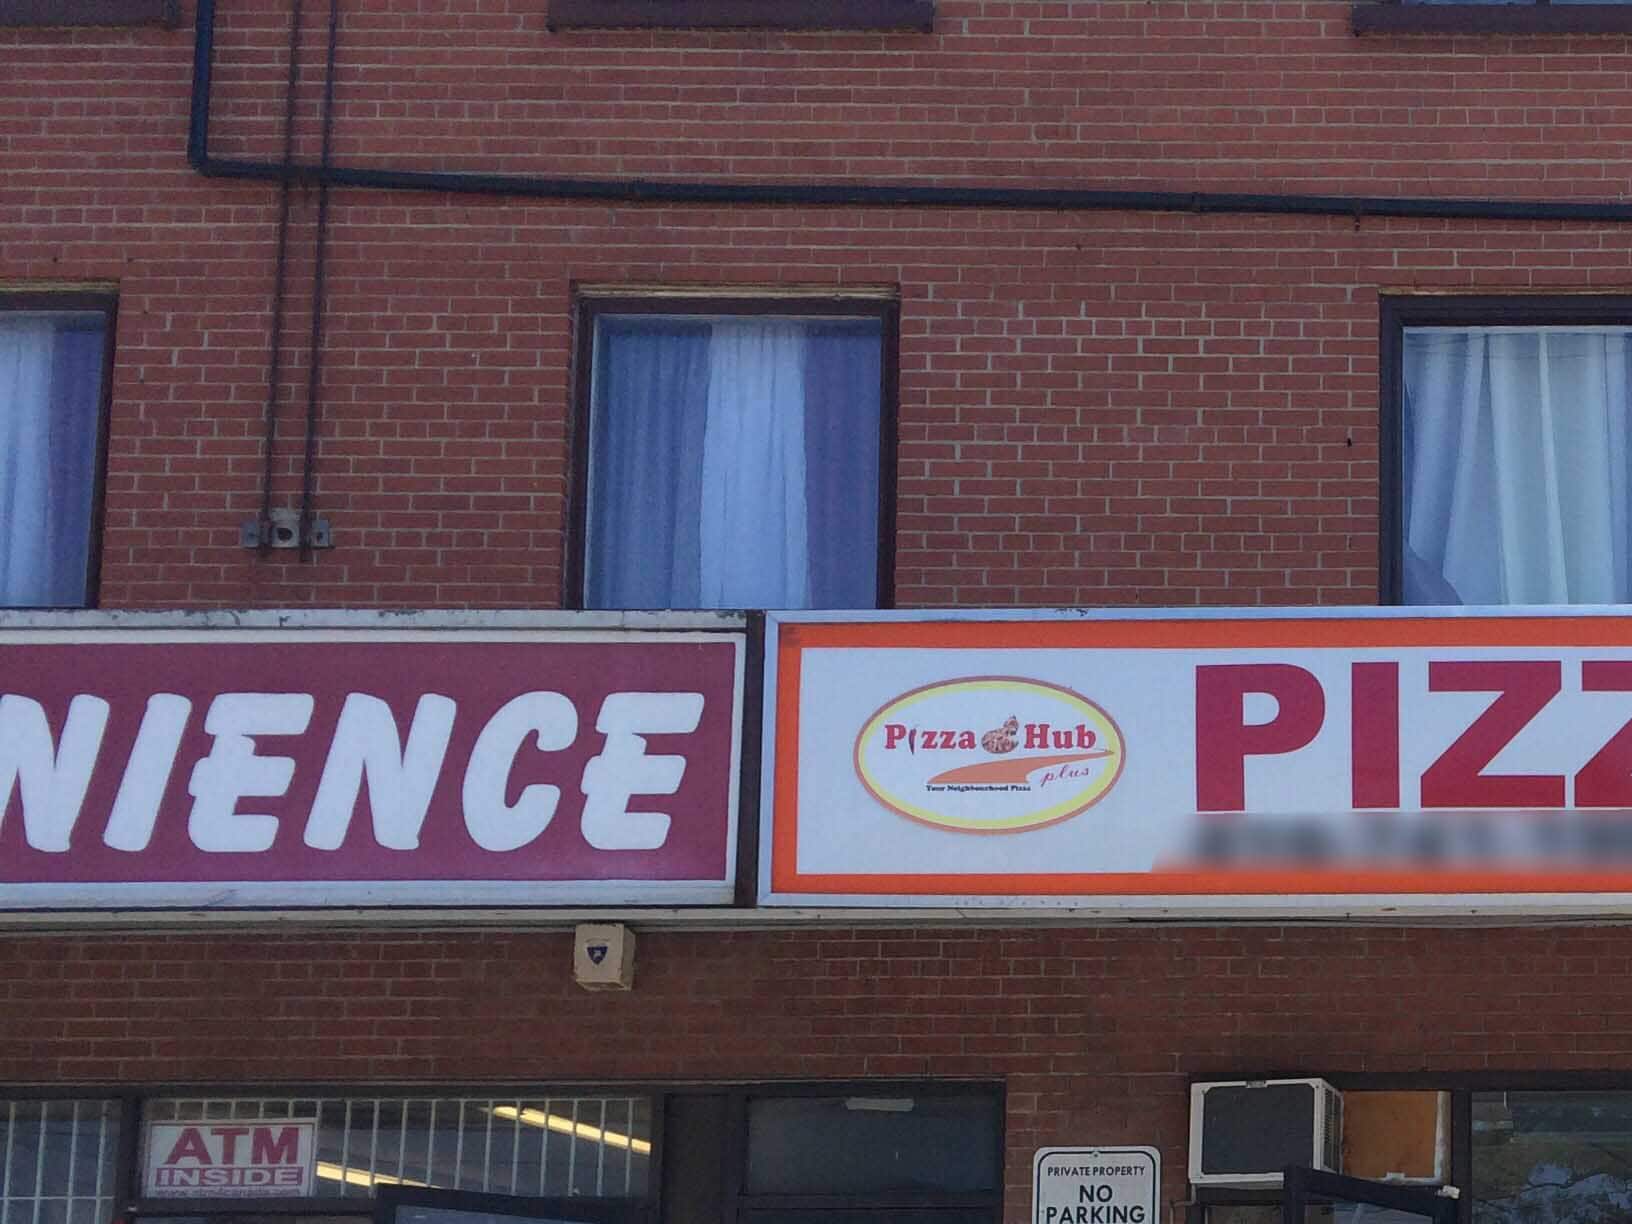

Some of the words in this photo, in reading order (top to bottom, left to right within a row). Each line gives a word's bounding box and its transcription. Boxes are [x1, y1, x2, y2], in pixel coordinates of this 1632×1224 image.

[885, 724, 976, 755] Pizza
[1024, 724, 1096, 749] Hub
[0, 691, 704, 851] NIENCE
[1041, 764, 1090, 788] plus
[163, 1127, 300, 1165] ATM
[160, 1169, 300, 1186] INSIDE
[1047, 1166, 1090, 1177] PRIVATE
[1092, 1165, 1146, 1176] PROPERTY
[1079, 1184, 1113, 1203] NO
[1045, 1204, 1146, 1224] PARKING
